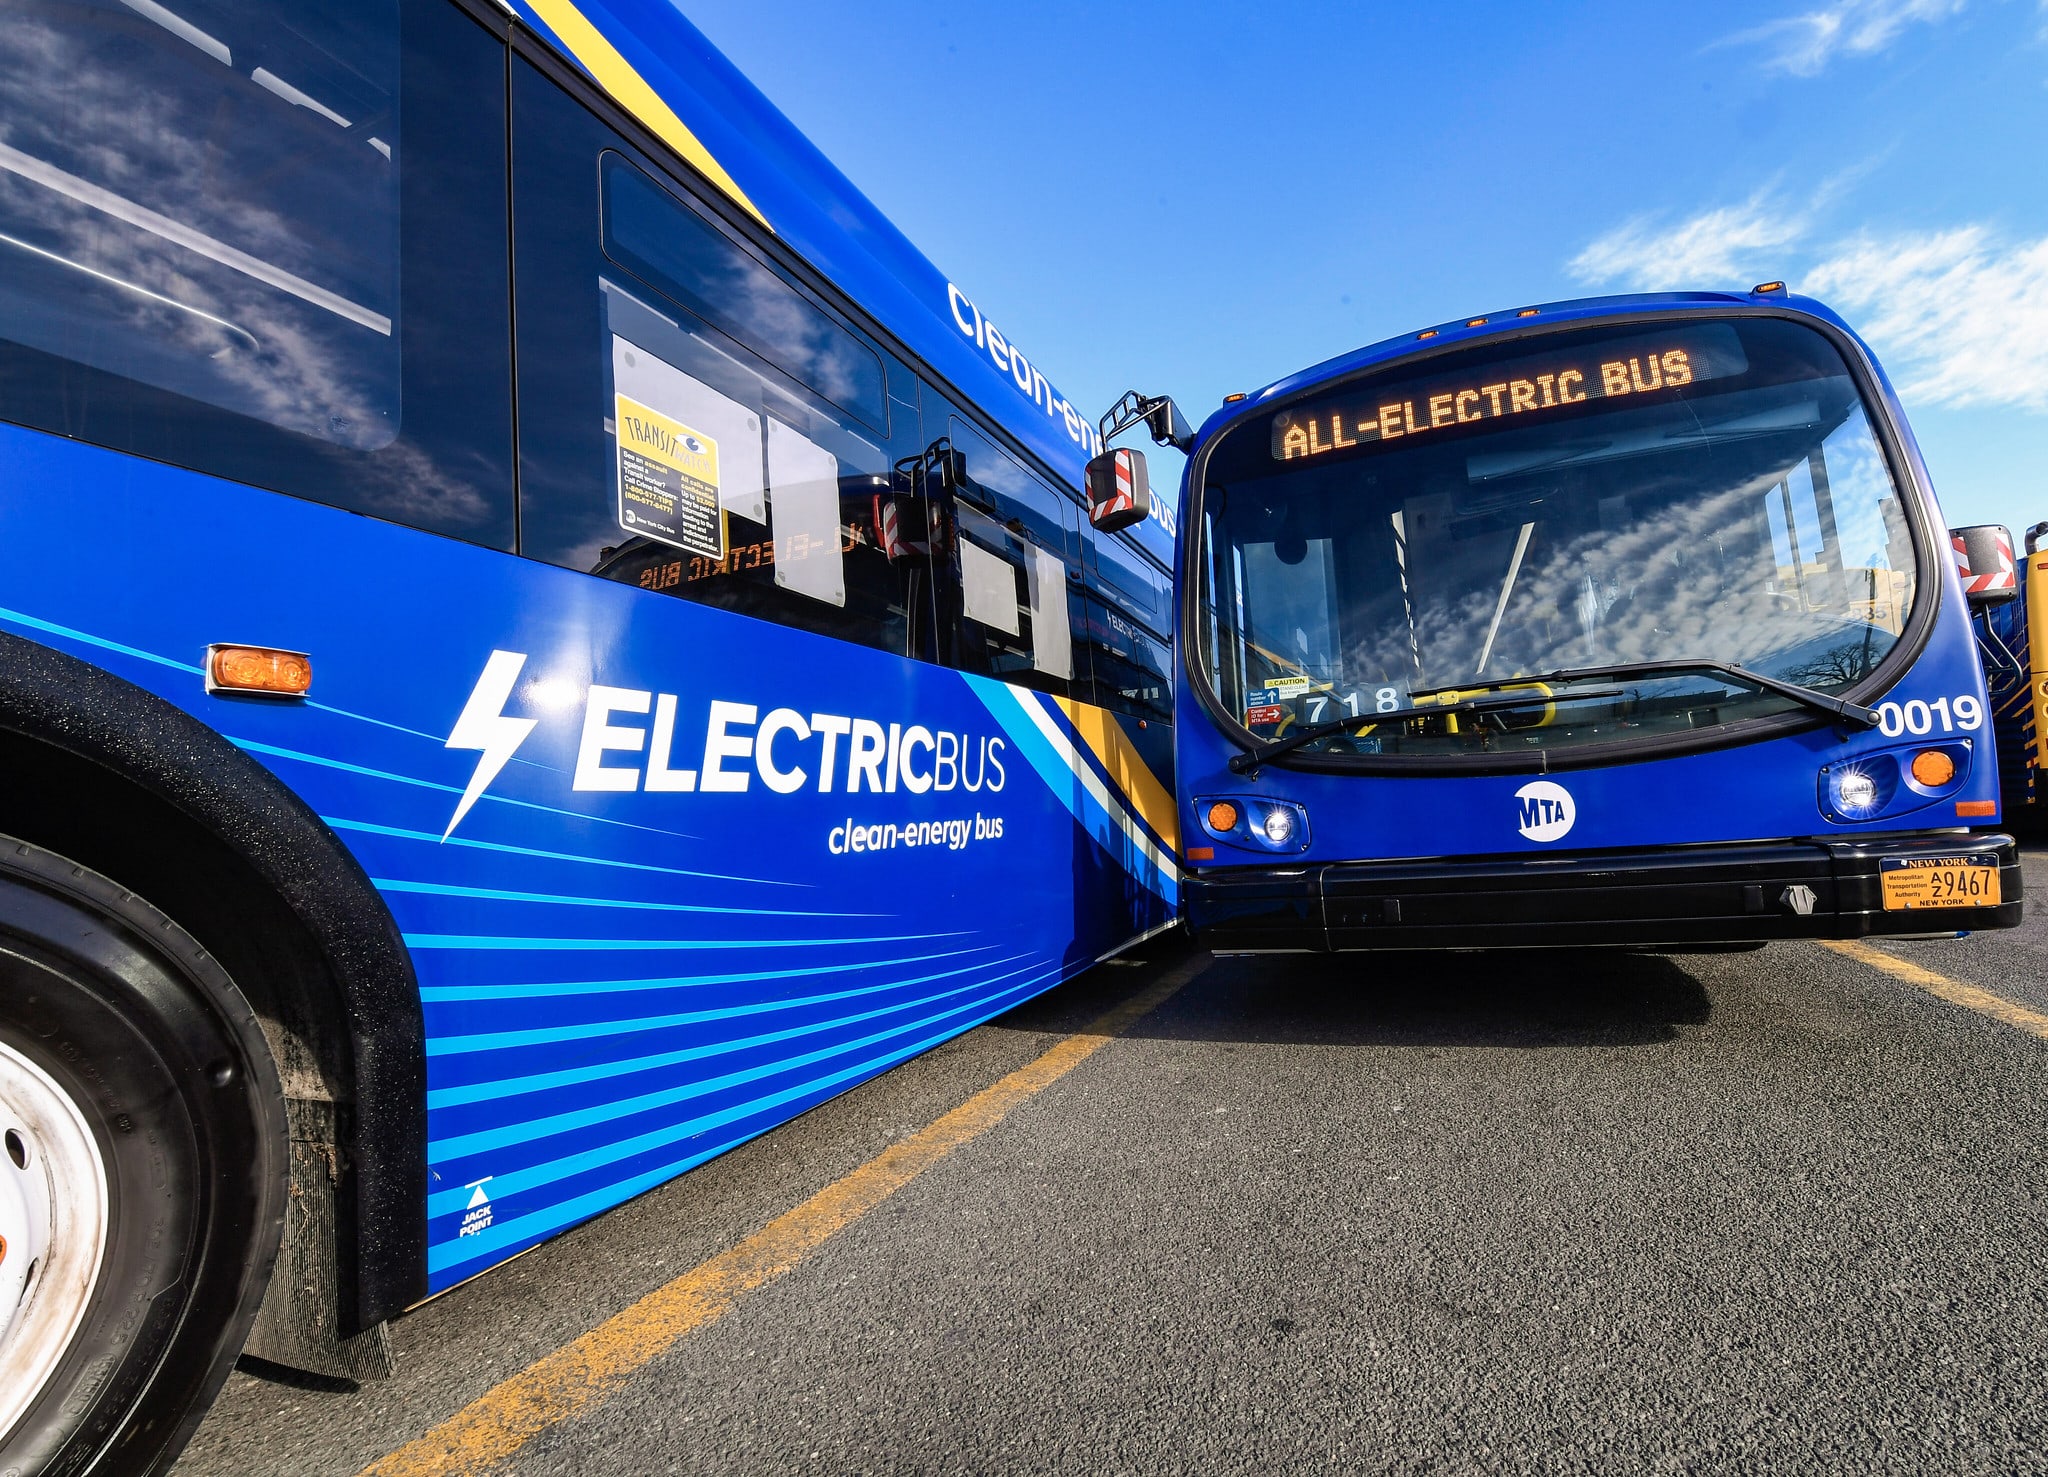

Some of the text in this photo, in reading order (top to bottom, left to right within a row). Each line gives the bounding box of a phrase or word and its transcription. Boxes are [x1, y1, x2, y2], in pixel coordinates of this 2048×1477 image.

[1283, 349, 1693, 460] ALL-ELECTRIC BUS
[624, 474, 636, 484] Call
[1274, 678, 1305, 686] CAUTION
[1878, 694, 1983, 738] 0019
[1514, 796, 1566, 830] MTA
[828, 813, 1004, 856] clean-energy bus
[1909, 857, 1969, 868] NEW YORK
[1887, 882, 1928, 890] Transportation
[1941, 898, 1965, 906] YORK
[461, 1204, 492, 1225] JACK
[459, 1215, 494, 1238] POINT
